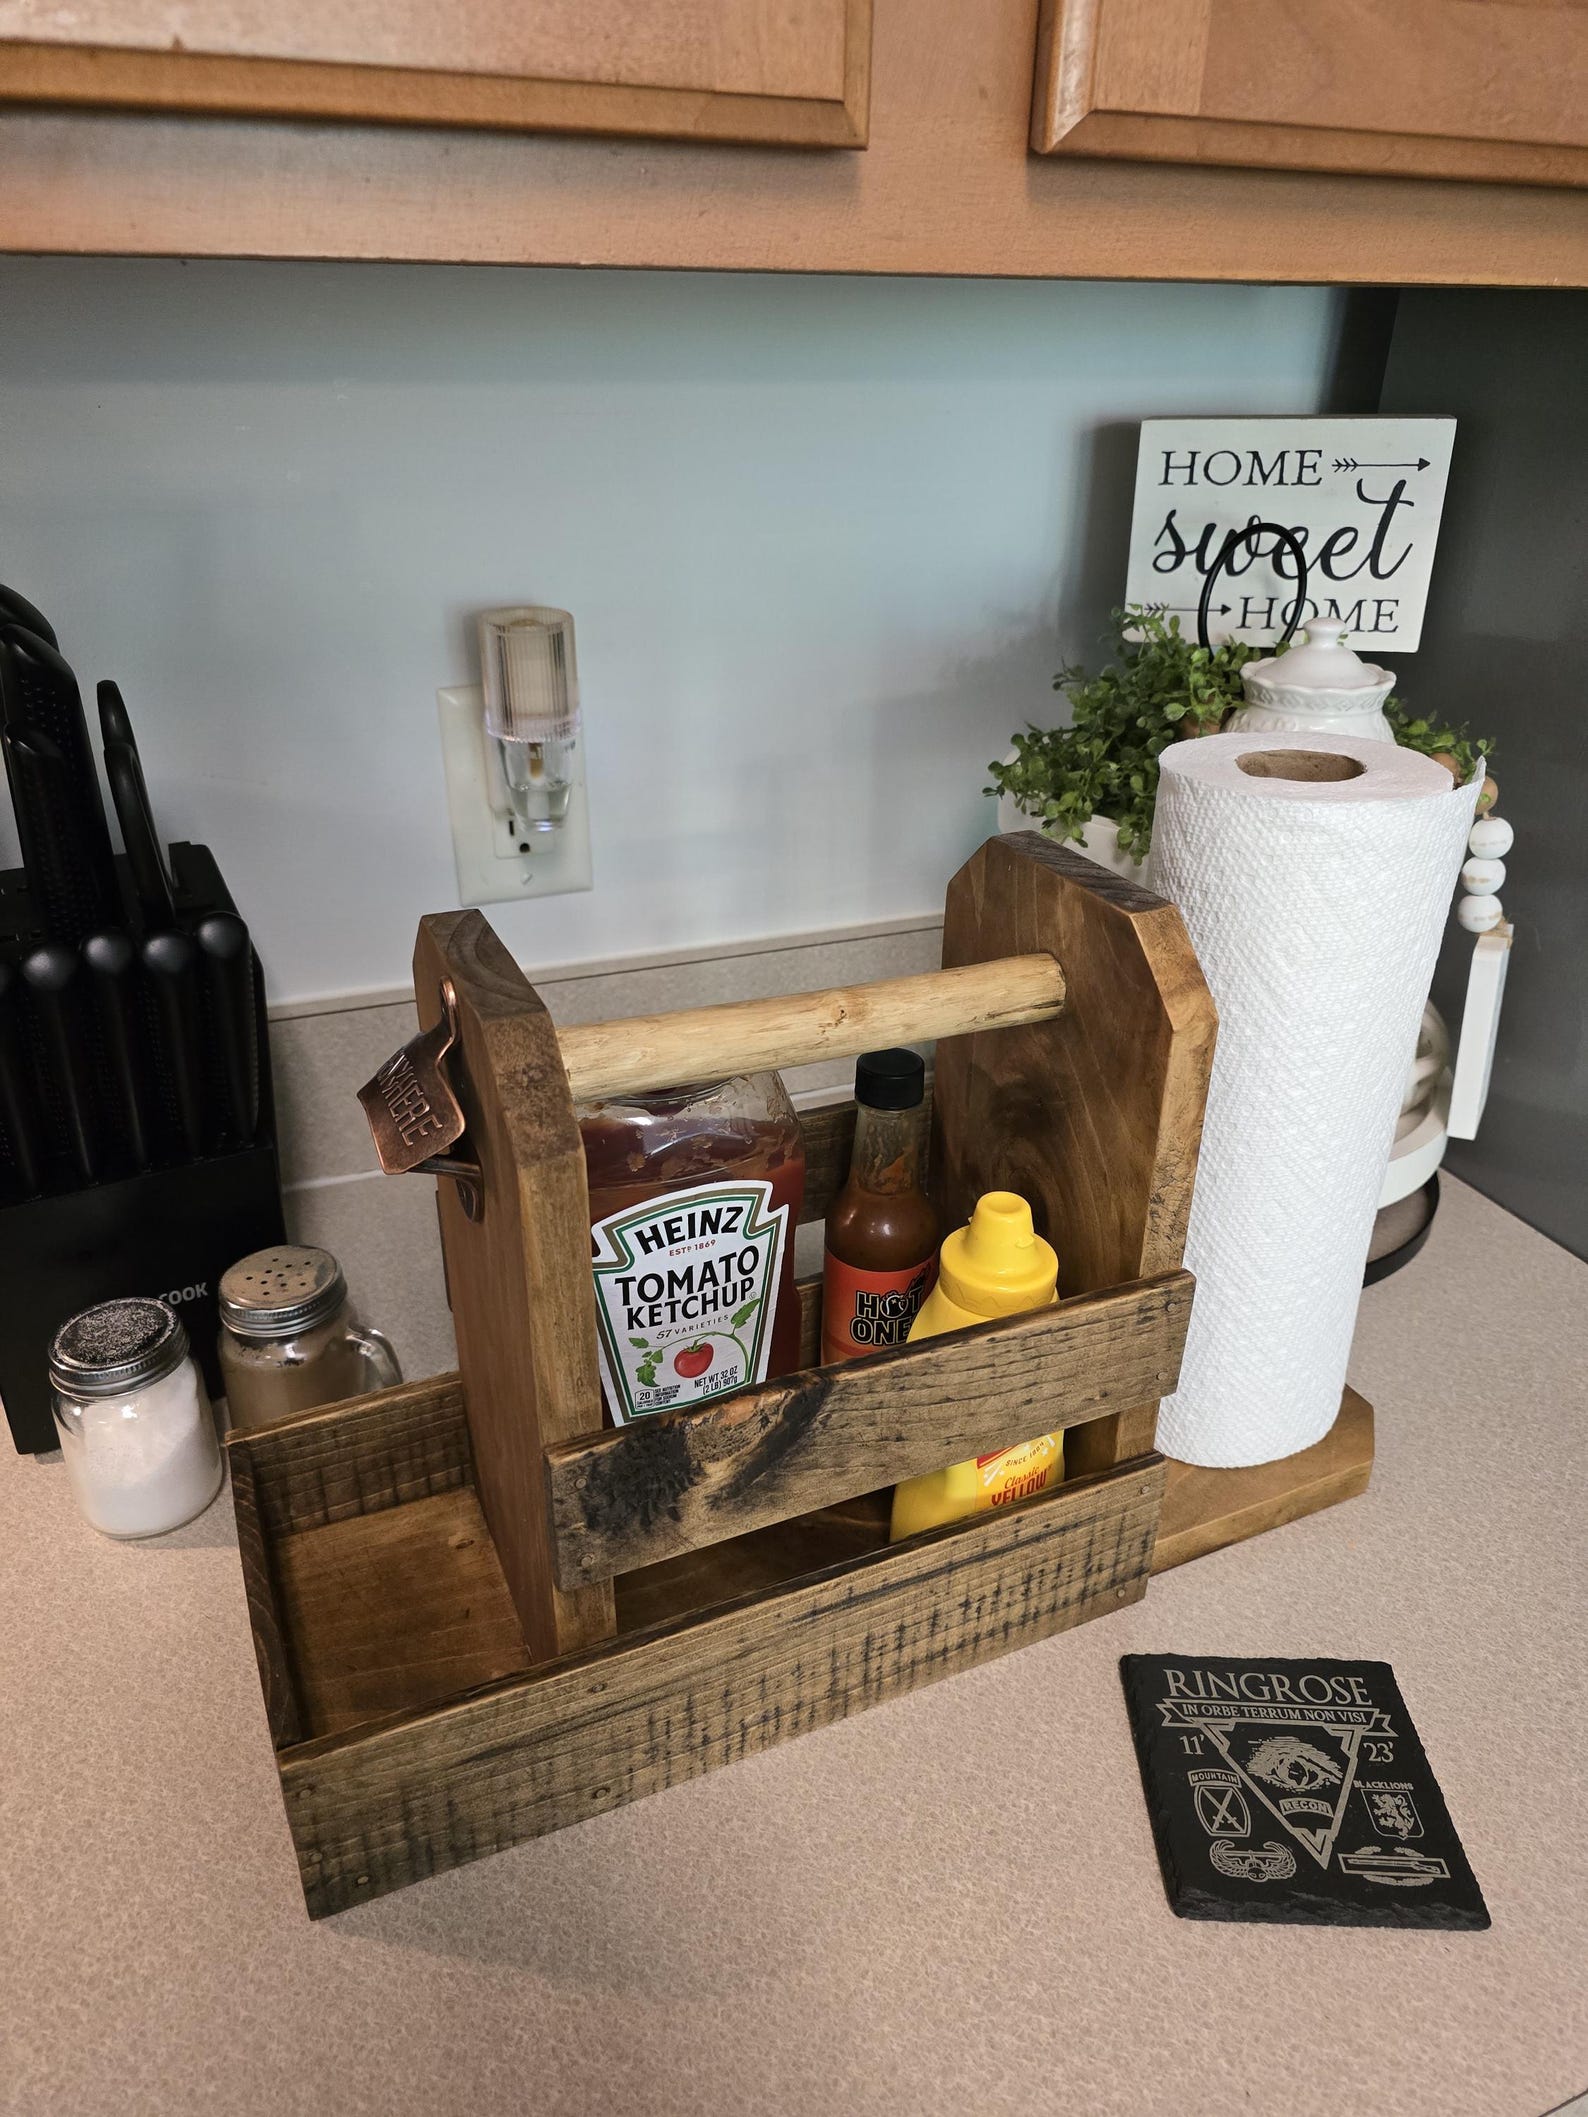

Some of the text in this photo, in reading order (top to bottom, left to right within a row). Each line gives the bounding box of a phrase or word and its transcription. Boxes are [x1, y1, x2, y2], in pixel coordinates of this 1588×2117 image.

[1158, 450, 1323, 486] HOME
[1153, 479, 1414, 581] sweet
[1236, 597, 1399, 633] HOME
[634, 1206, 744, 1255] HEINZ
[695, 1240, 716, 1251] 1869
[615, 1246, 760, 1306] TOMATO
[627, 1277, 754, 1330] KETCHUP
[856, 1286, 923, 1319] HOT
[656, 1314, 729, 1340] 57 VARIETIES
[694, 1365, 738, 1388] NET WT 32 OZ
[703, 1384, 710, 1395] (2
[711, 1380, 721, 1392] LB)
[640, 1391, 650, 1400] 20
[1005, 1456, 1027, 1467] SINCE
[1005, 1466, 1040, 1489] Classic
[1163, 1669, 1372, 1706] RINGROSE
[1182, 1703, 1367, 1723] IN ORBE TERRUM NON VISI
[1192, 1769, 1239, 1785] MOUNTAIN
[1284, 1799, 1331, 1814] RECON
